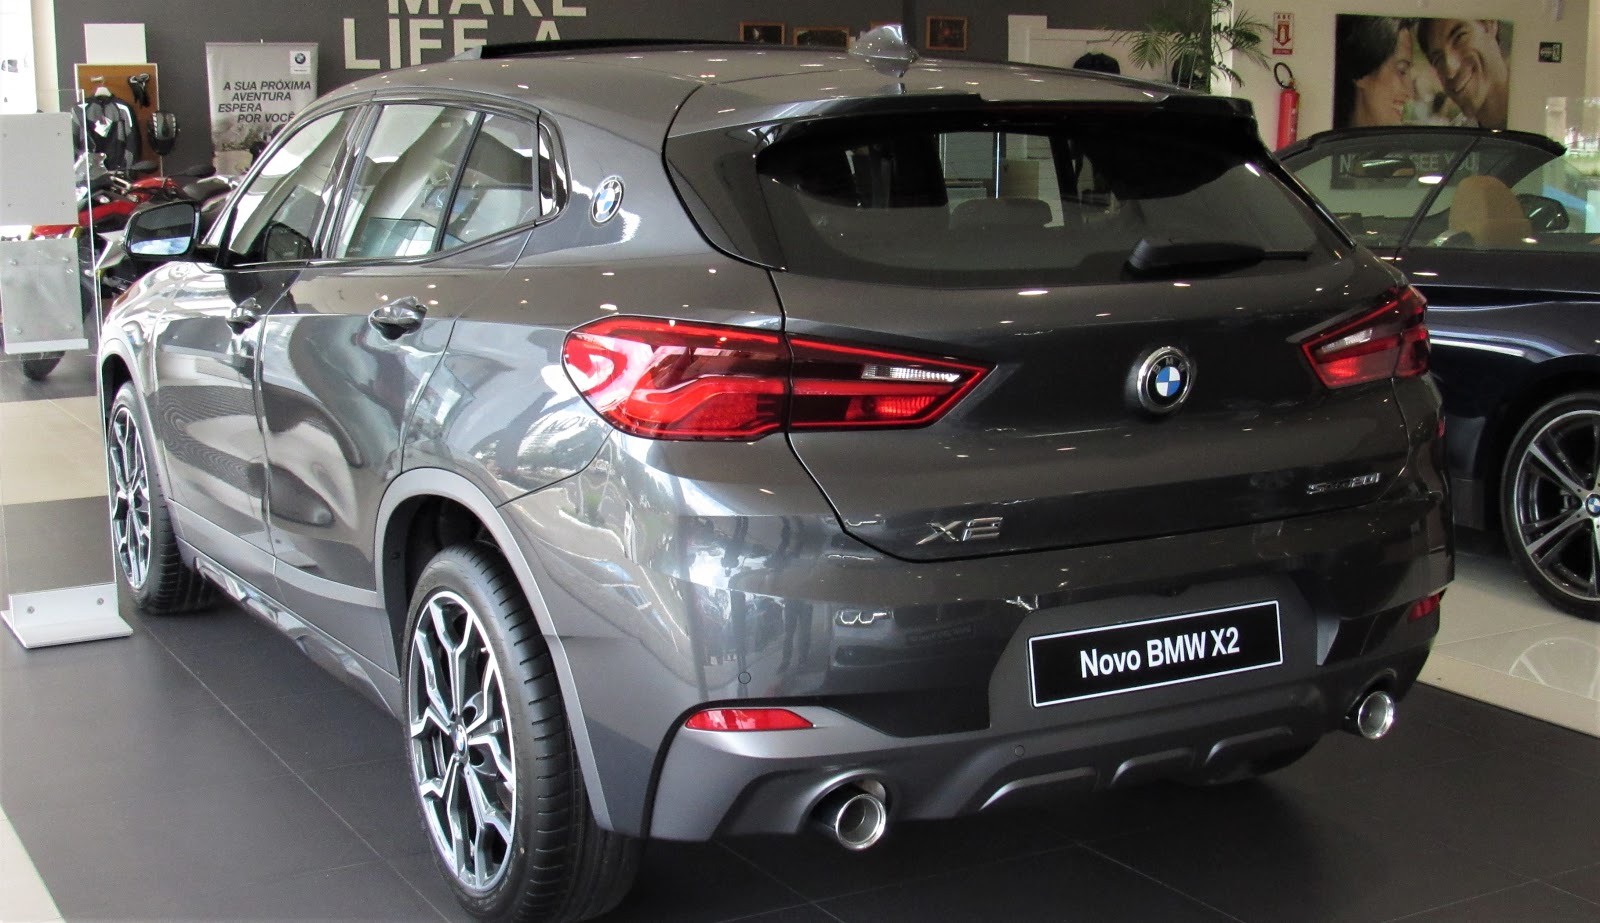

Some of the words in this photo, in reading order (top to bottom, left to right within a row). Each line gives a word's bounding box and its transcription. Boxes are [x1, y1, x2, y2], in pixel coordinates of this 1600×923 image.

[223, 81, 231, 91] A
[234, 81, 257, 91] SUA
[260, 79, 311, 91] PRÓXIMA
[231, 92, 292, 102] AVENTURA
[218, 103, 262, 113] ESPERA
[237, 114, 261, 123] POR
[916, 516, 1004, 546] X2
[1080, 648, 1142, 679] Novo
[1146, 631, 1207, 668] BMW
[1210, 626, 1241, 657] X2
